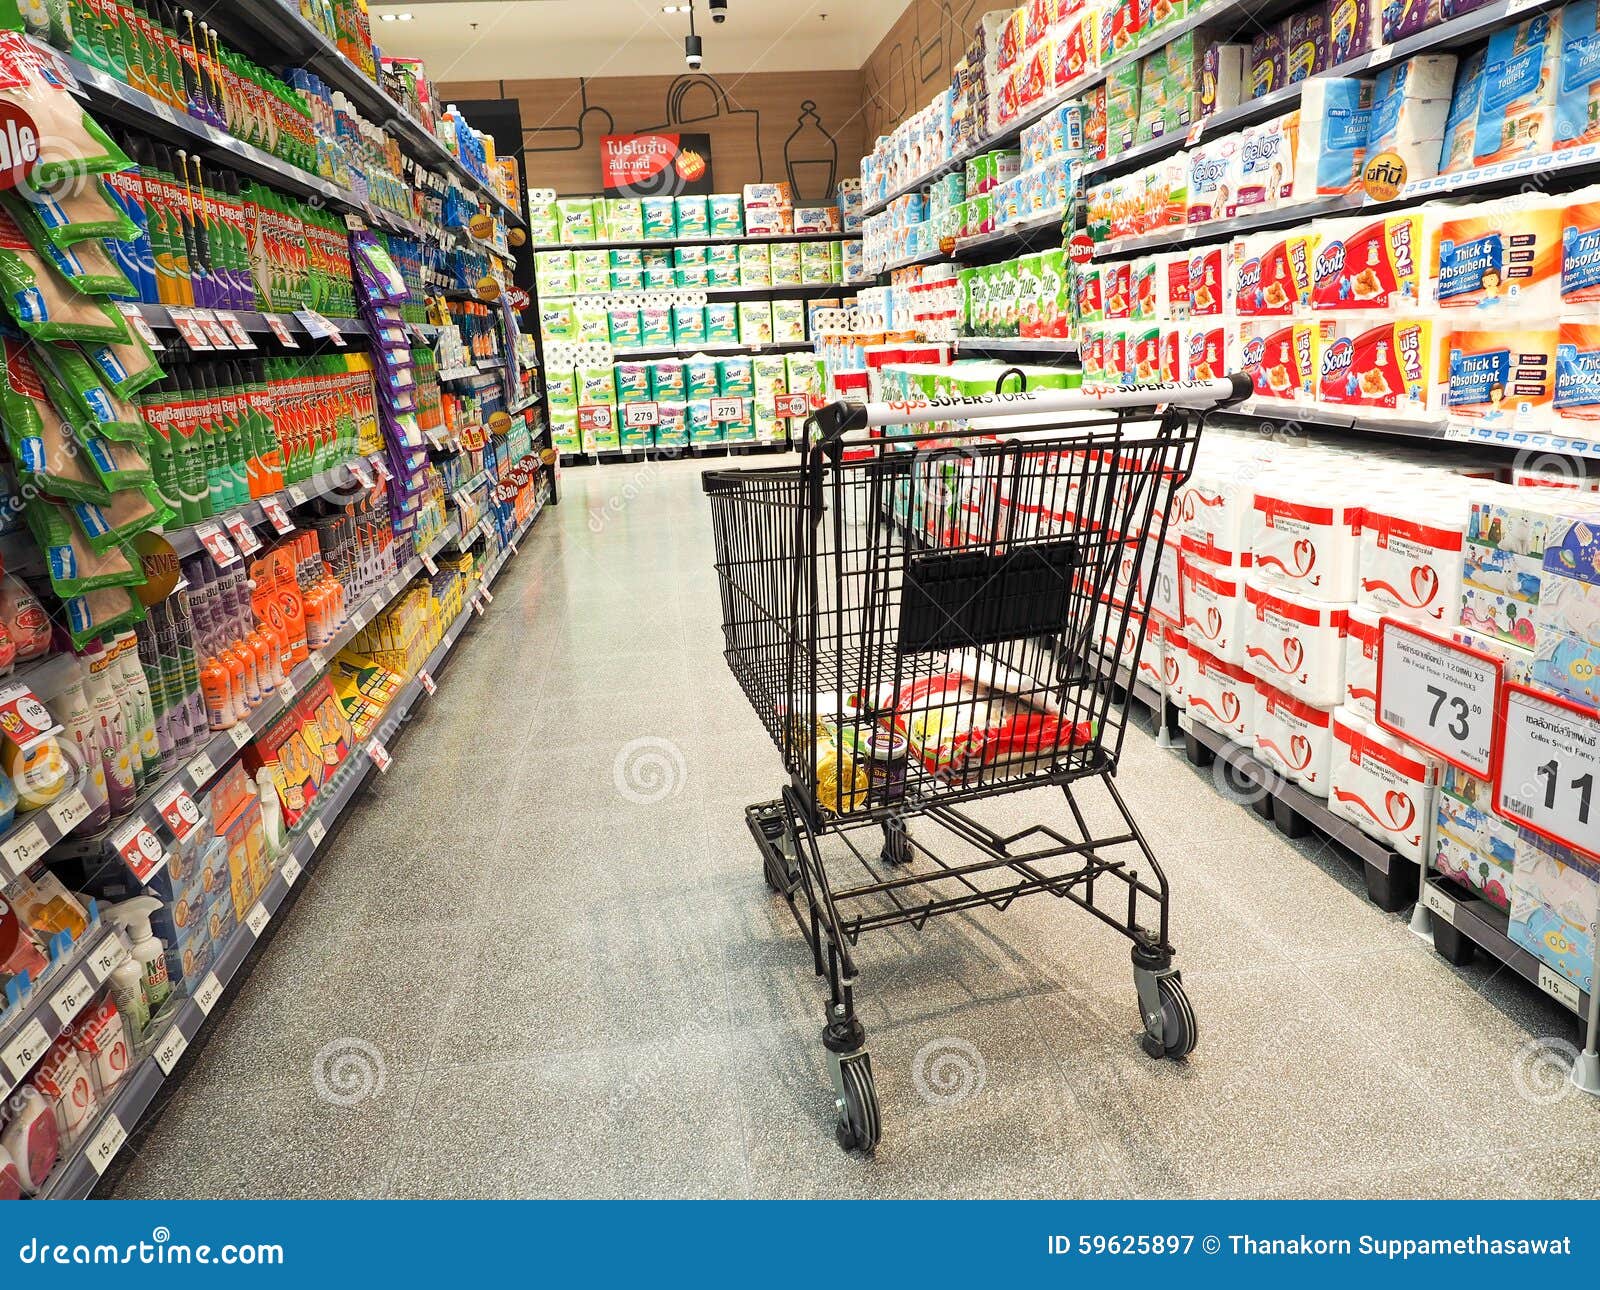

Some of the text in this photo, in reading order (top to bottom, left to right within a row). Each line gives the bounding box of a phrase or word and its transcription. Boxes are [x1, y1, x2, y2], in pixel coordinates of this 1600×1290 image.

[1505, 57, 1531, 75] Handy
[1498, 70, 1525, 89] Towels
[1242, 135, 1280, 162] Cellox
[1395, 247, 1412, 269] 2
[1456, 246, 1480, 262] Thick
[1295, 264, 1307, 278] 2
[1315, 248, 1346, 281] Scott
[1439, 256, 1493, 280] Absorbent
[1236, 264, 1262, 291] Scott
[1439, 273, 1479, 289] Paper Towels
[1511, 287, 1517, 296] 6
[1242, 345, 1265, 369] Scott
[1299, 350, 1311, 368] 2
[1322, 343, 1354, 374] Scott
[1403, 350, 1420, 371] 2
[1462, 358, 1489, 373] Thick
[621, 375, 637, 385] Scott
[657, 374, 673, 383] Scott
[691, 373, 706, 382] Scott
[726, 370, 741, 379] Scott
[1450, 370, 1499, 388] Absorbent
[586, 379, 601, 389] Scott
[1450, 389, 1464, 397] Paper
[634, 411, 653, 421] 279
[718, 407, 736, 416] 279
[1521, 403, 1528, 413] 6
[497, 483, 519, 501] Sale
[1389, 545, 1406, 557] Kitchen
[1474, 672, 1484, 683] X3
[26, 704, 42, 718] 109
[1426, 684, 1470, 741] 73
[1530, 731, 1550, 744] Cellox
[1575, 747, 1595, 762] Fancy
[1362, 763, 1379, 778] Kitchen
[1380, 772, 1396, 785] Towel
[1537, 759, 1593, 825] 11
[181, 801, 192, 812] 122
[59, 808, 74, 824] 73
[143, 836, 155, 849] 122
[13, 845, 29, 861] 73
[1430, 896, 1439, 909] 63
[99, 955, 111, 971] 76
[1542, 976, 1559, 994] 115
[62, 995, 76, 1012] 76
[200, 990, 212, 1008] 138
[17, 1048, 32, 1068] 76
[160, 1046, 174, 1066] 195
[98, 1142, 110, 1160] 15
